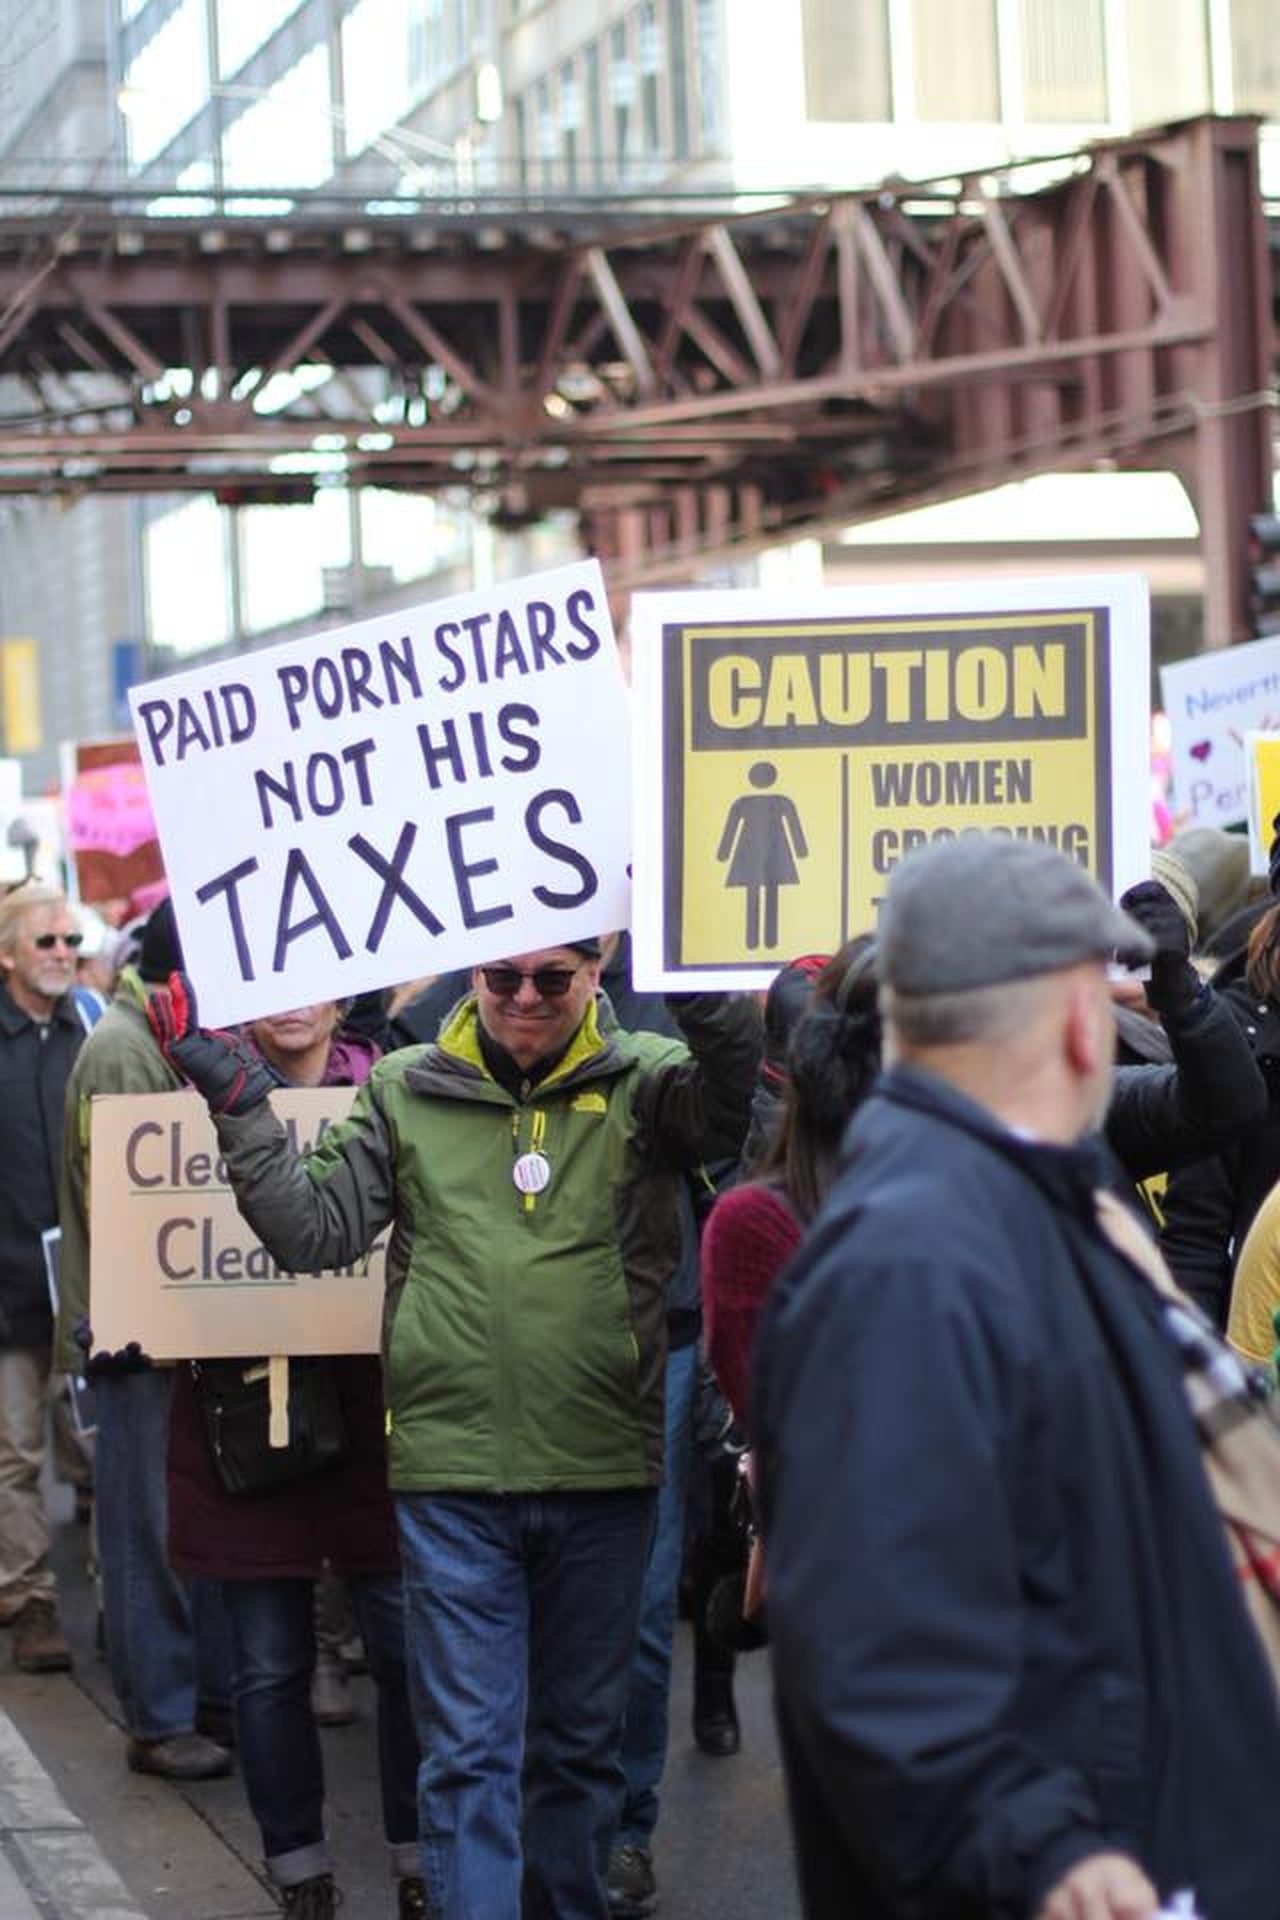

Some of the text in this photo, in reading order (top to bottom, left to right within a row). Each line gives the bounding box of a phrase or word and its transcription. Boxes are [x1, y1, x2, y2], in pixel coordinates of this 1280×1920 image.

[138, 589, 601, 766] PAID PORN STARS
[707, 643, 1066, 729] CAUTION
[254, 703, 541, 829] NOT HIS
[871, 758, 1033, 808] WOMEN
[1189, 779, 1247, 817] Per
[195, 788, 599, 981] TAXES
[126, 1121, 230, 1187] Clea
[157, 1217, 296, 1280] Clea
